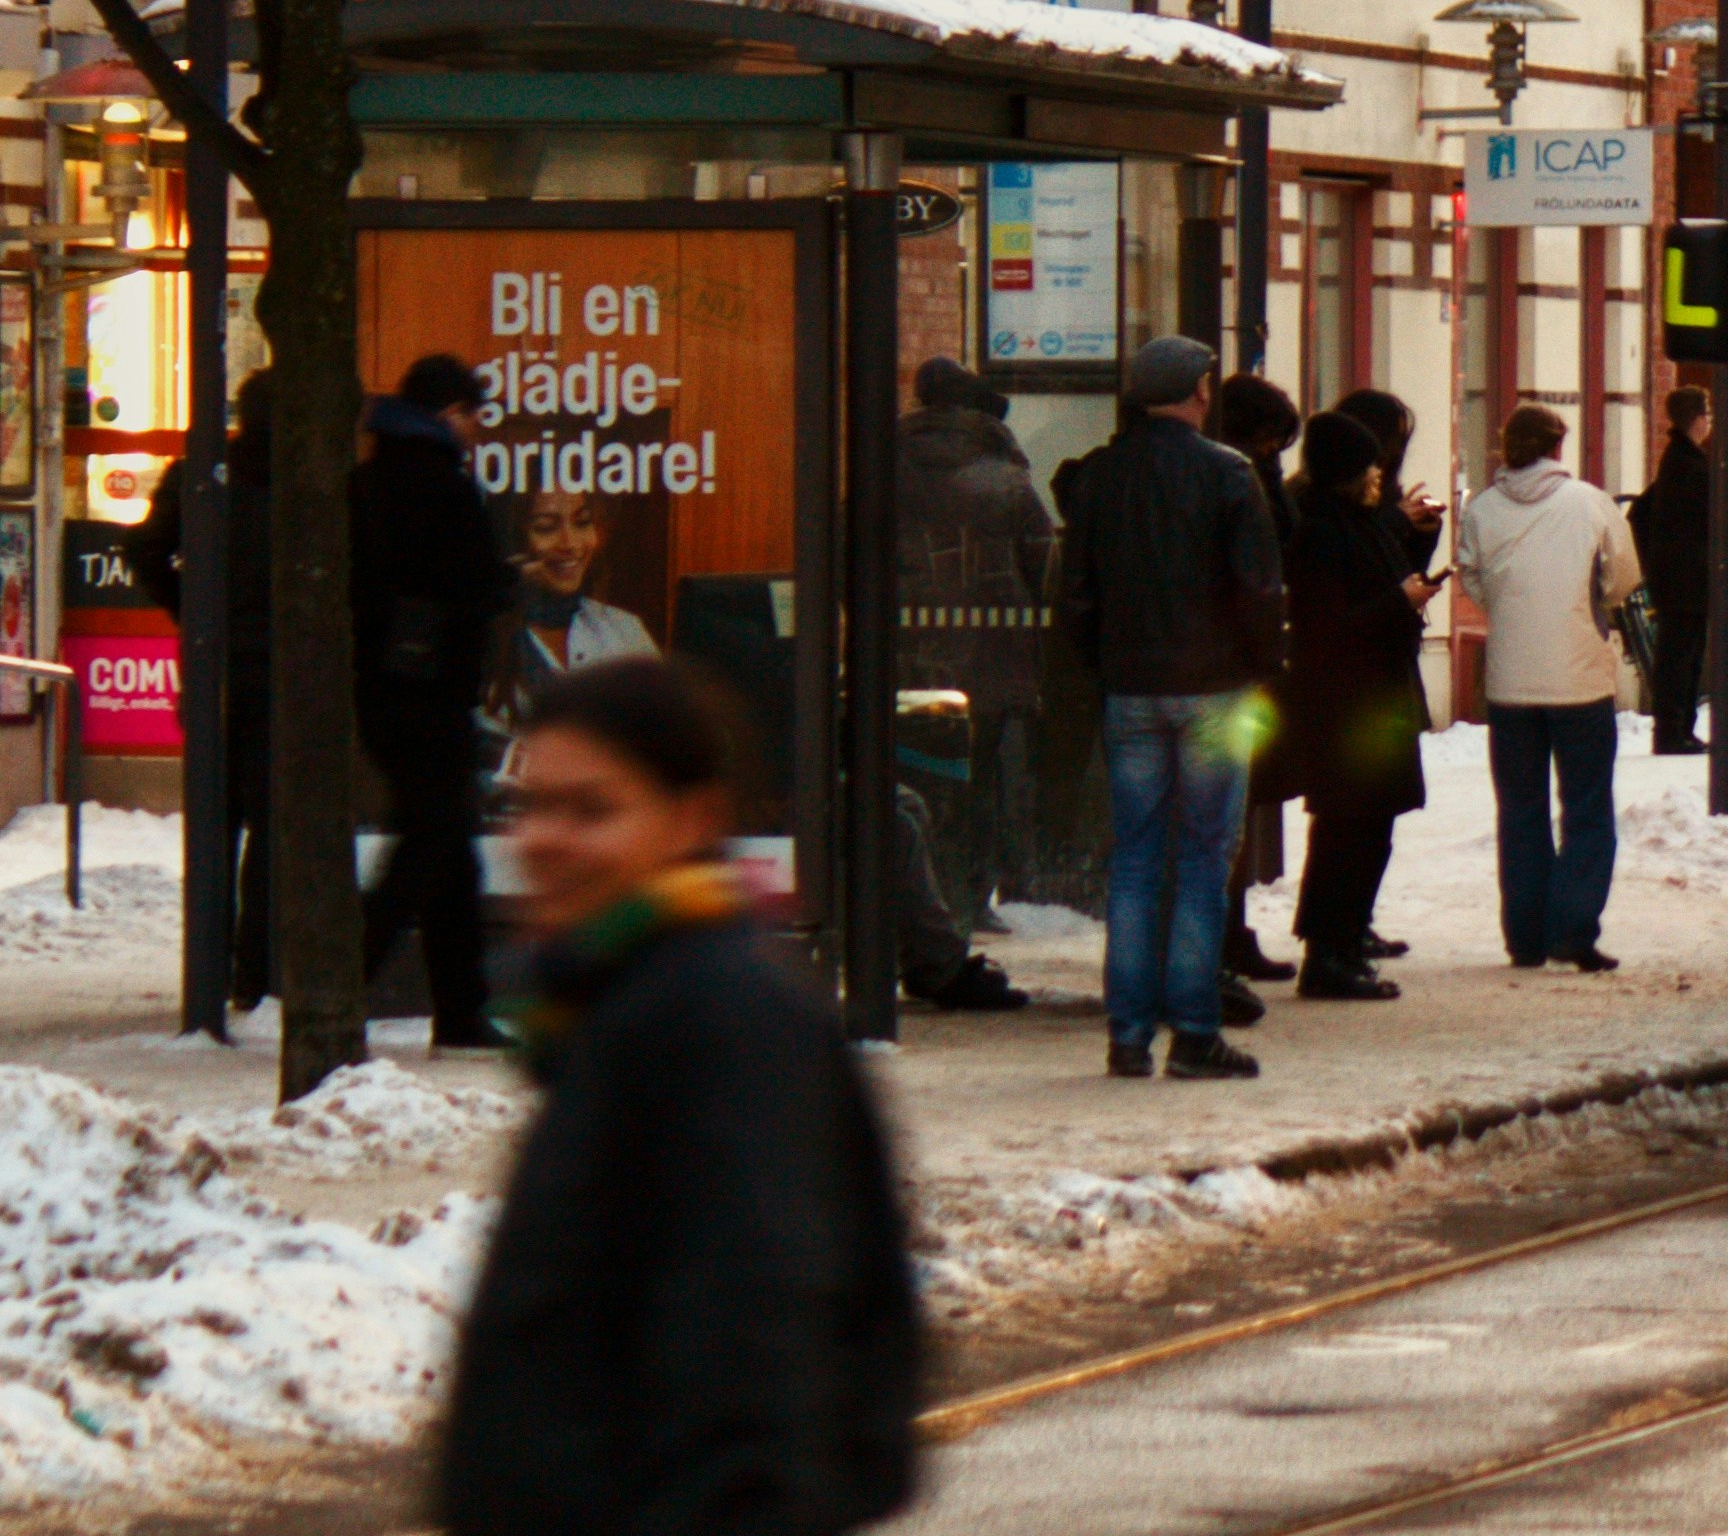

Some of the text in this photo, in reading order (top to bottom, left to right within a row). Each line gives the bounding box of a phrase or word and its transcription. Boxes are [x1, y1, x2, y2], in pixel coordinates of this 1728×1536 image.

[1534, 139, 1626, 172] ICAP
[491, 271, 562, 335] Bli
[583, 283, 659, 336] en
[475, 351, 682, 427] glädje-
[464, 430, 716, 494] pridare!
